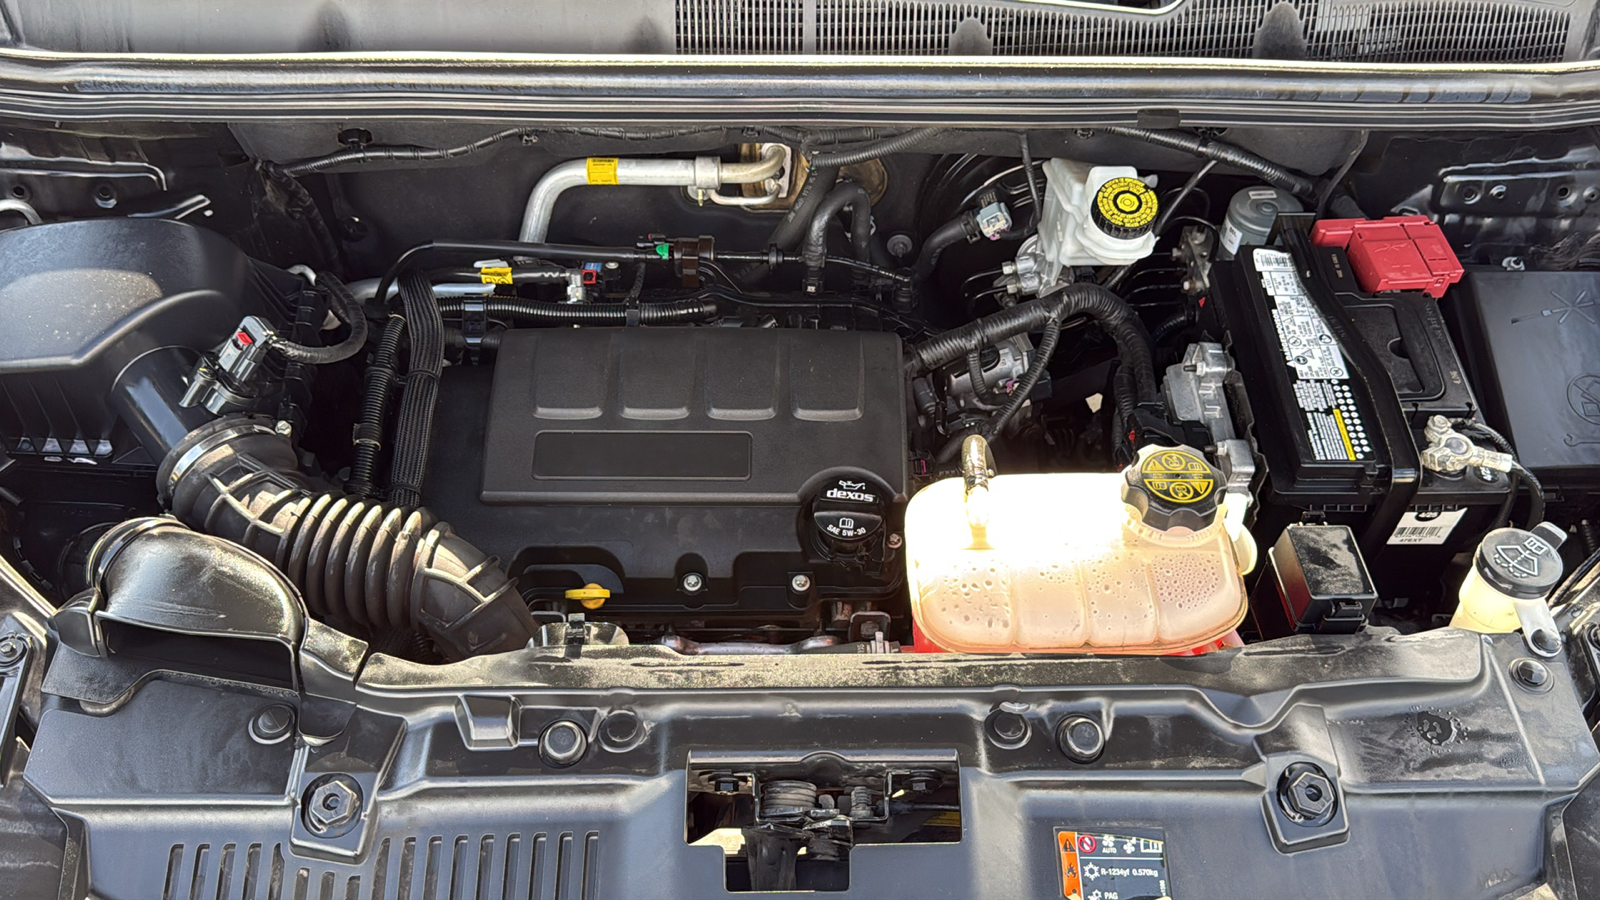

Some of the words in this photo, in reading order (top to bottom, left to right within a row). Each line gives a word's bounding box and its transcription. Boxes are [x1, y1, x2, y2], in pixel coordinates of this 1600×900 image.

[826, 488, 874, 502] dexos
[827, 524, 840, 535] SAE
[842, 527, 866, 537] 5W-30
[1101, 868, 1130, 877] R-1234yf
[1132, 868, 1159, 878] 0.570kg
[1104, 892, 1119, 900] PAG
